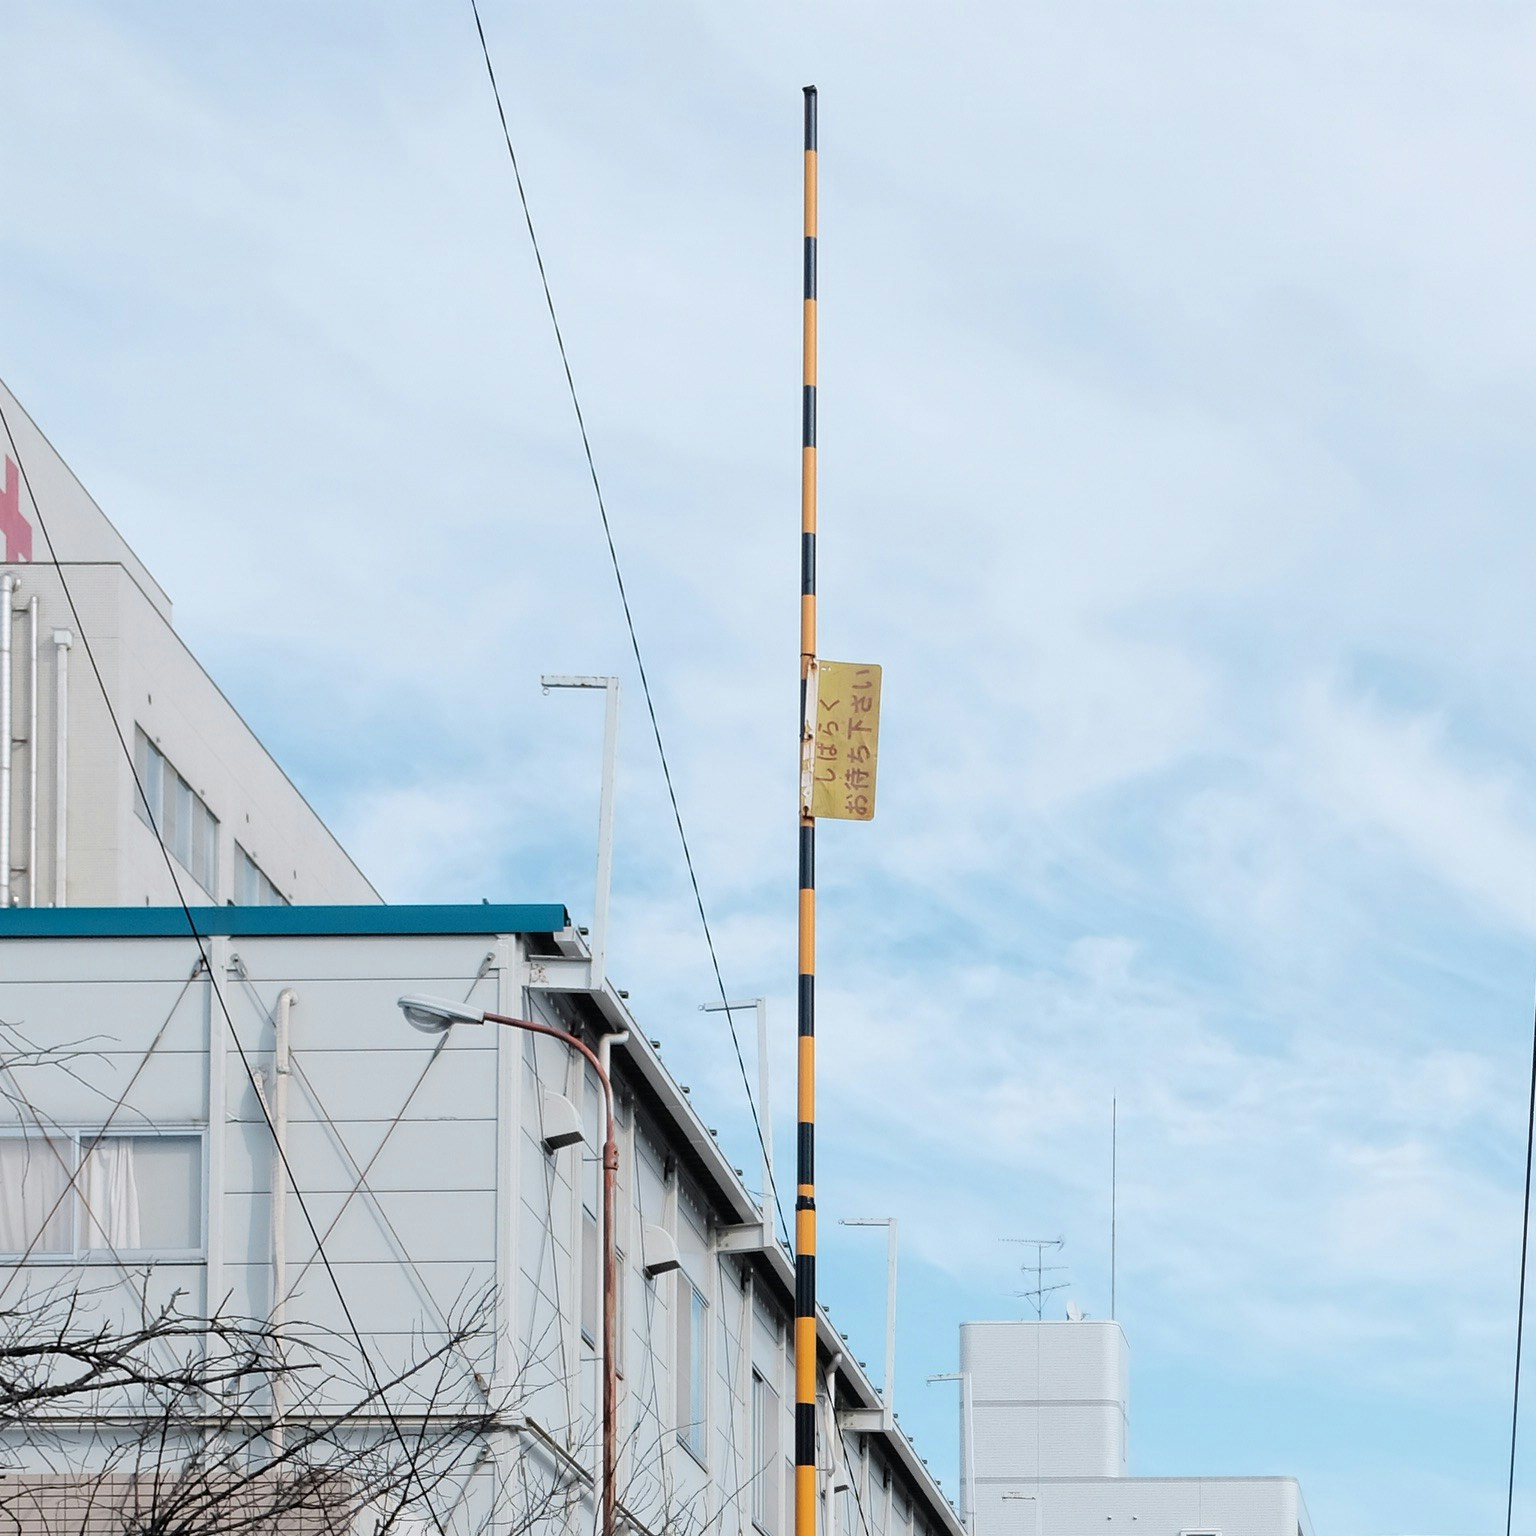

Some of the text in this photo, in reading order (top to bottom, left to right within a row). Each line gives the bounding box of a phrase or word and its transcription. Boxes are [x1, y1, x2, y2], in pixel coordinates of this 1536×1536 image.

[816, 699, 840, 782] しばらく
[845, 669, 873, 815] お待ち下さい
